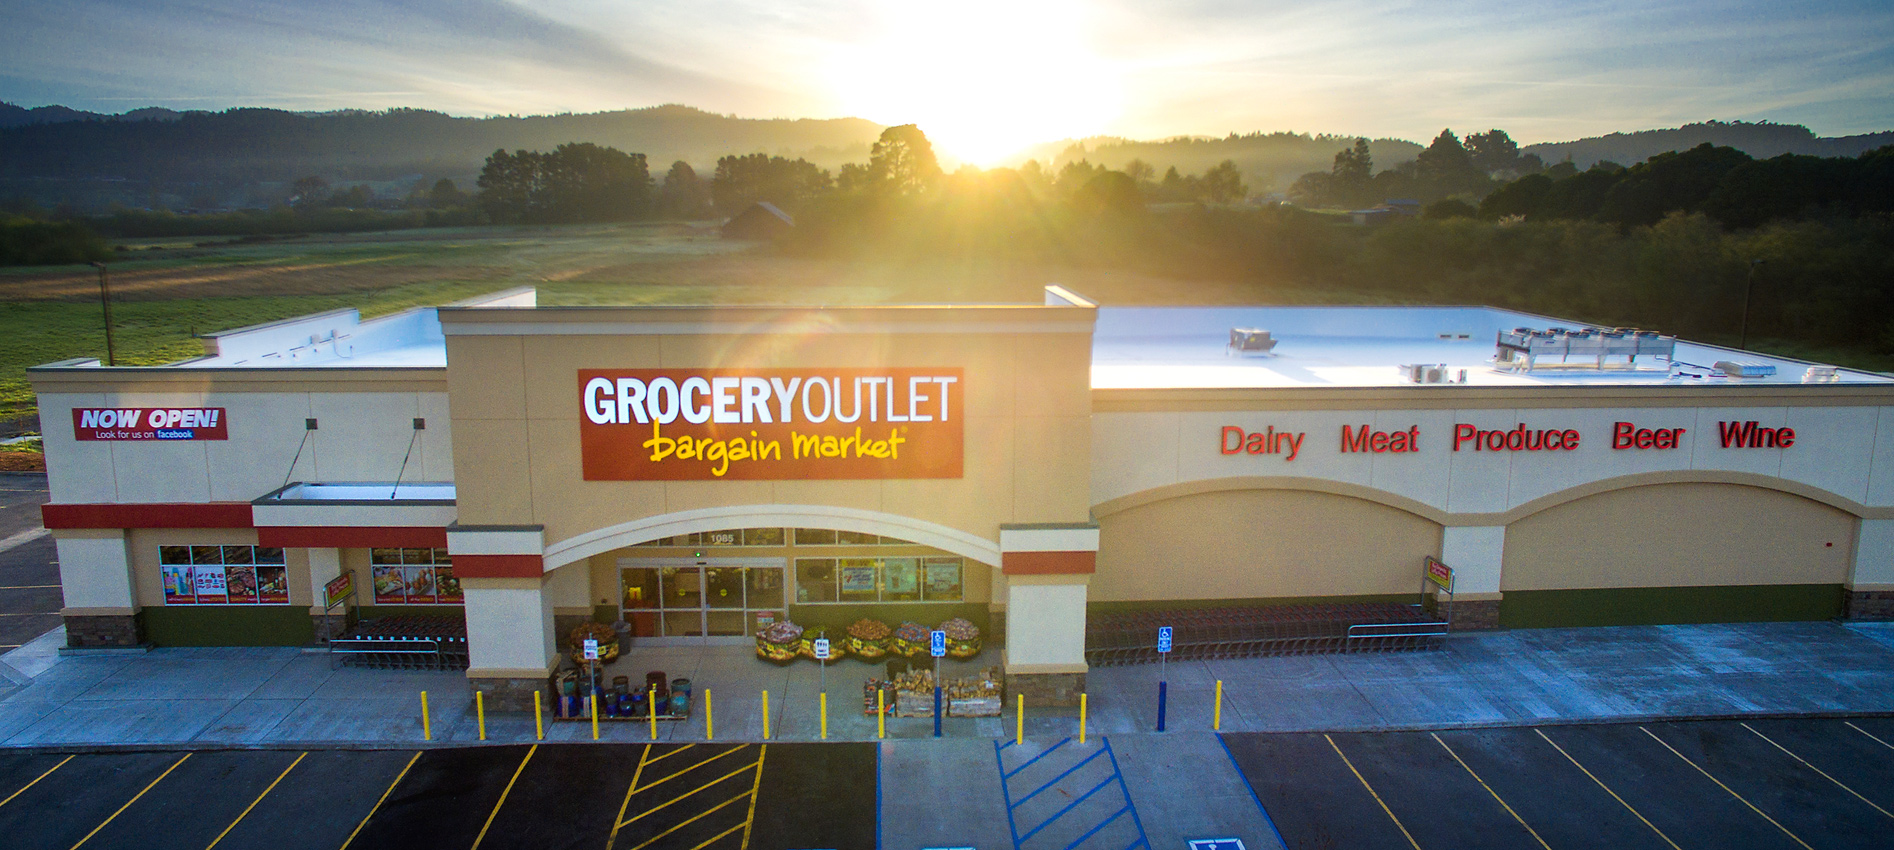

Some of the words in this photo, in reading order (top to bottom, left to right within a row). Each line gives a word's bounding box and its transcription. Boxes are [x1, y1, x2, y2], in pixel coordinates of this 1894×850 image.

[81, 410, 142, 428] NOW
[149, 410, 219, 428] OPEN!
[96, 430, 116, 439] Look
[117, 430, 130, 439] for
[157, 430, 193, 439] facebook
[1220, 425, 1305, 461] Dairy
[1341, 424, 1420, 453] Meat
[1453, 423, 1580, 452] Produce
[1612, 421, 1686, 449] Beer
[1718, 420, 1795, 449] Wine
[643, 417, 781, 477] bargain
[711, 534, 734, 543] 1085
